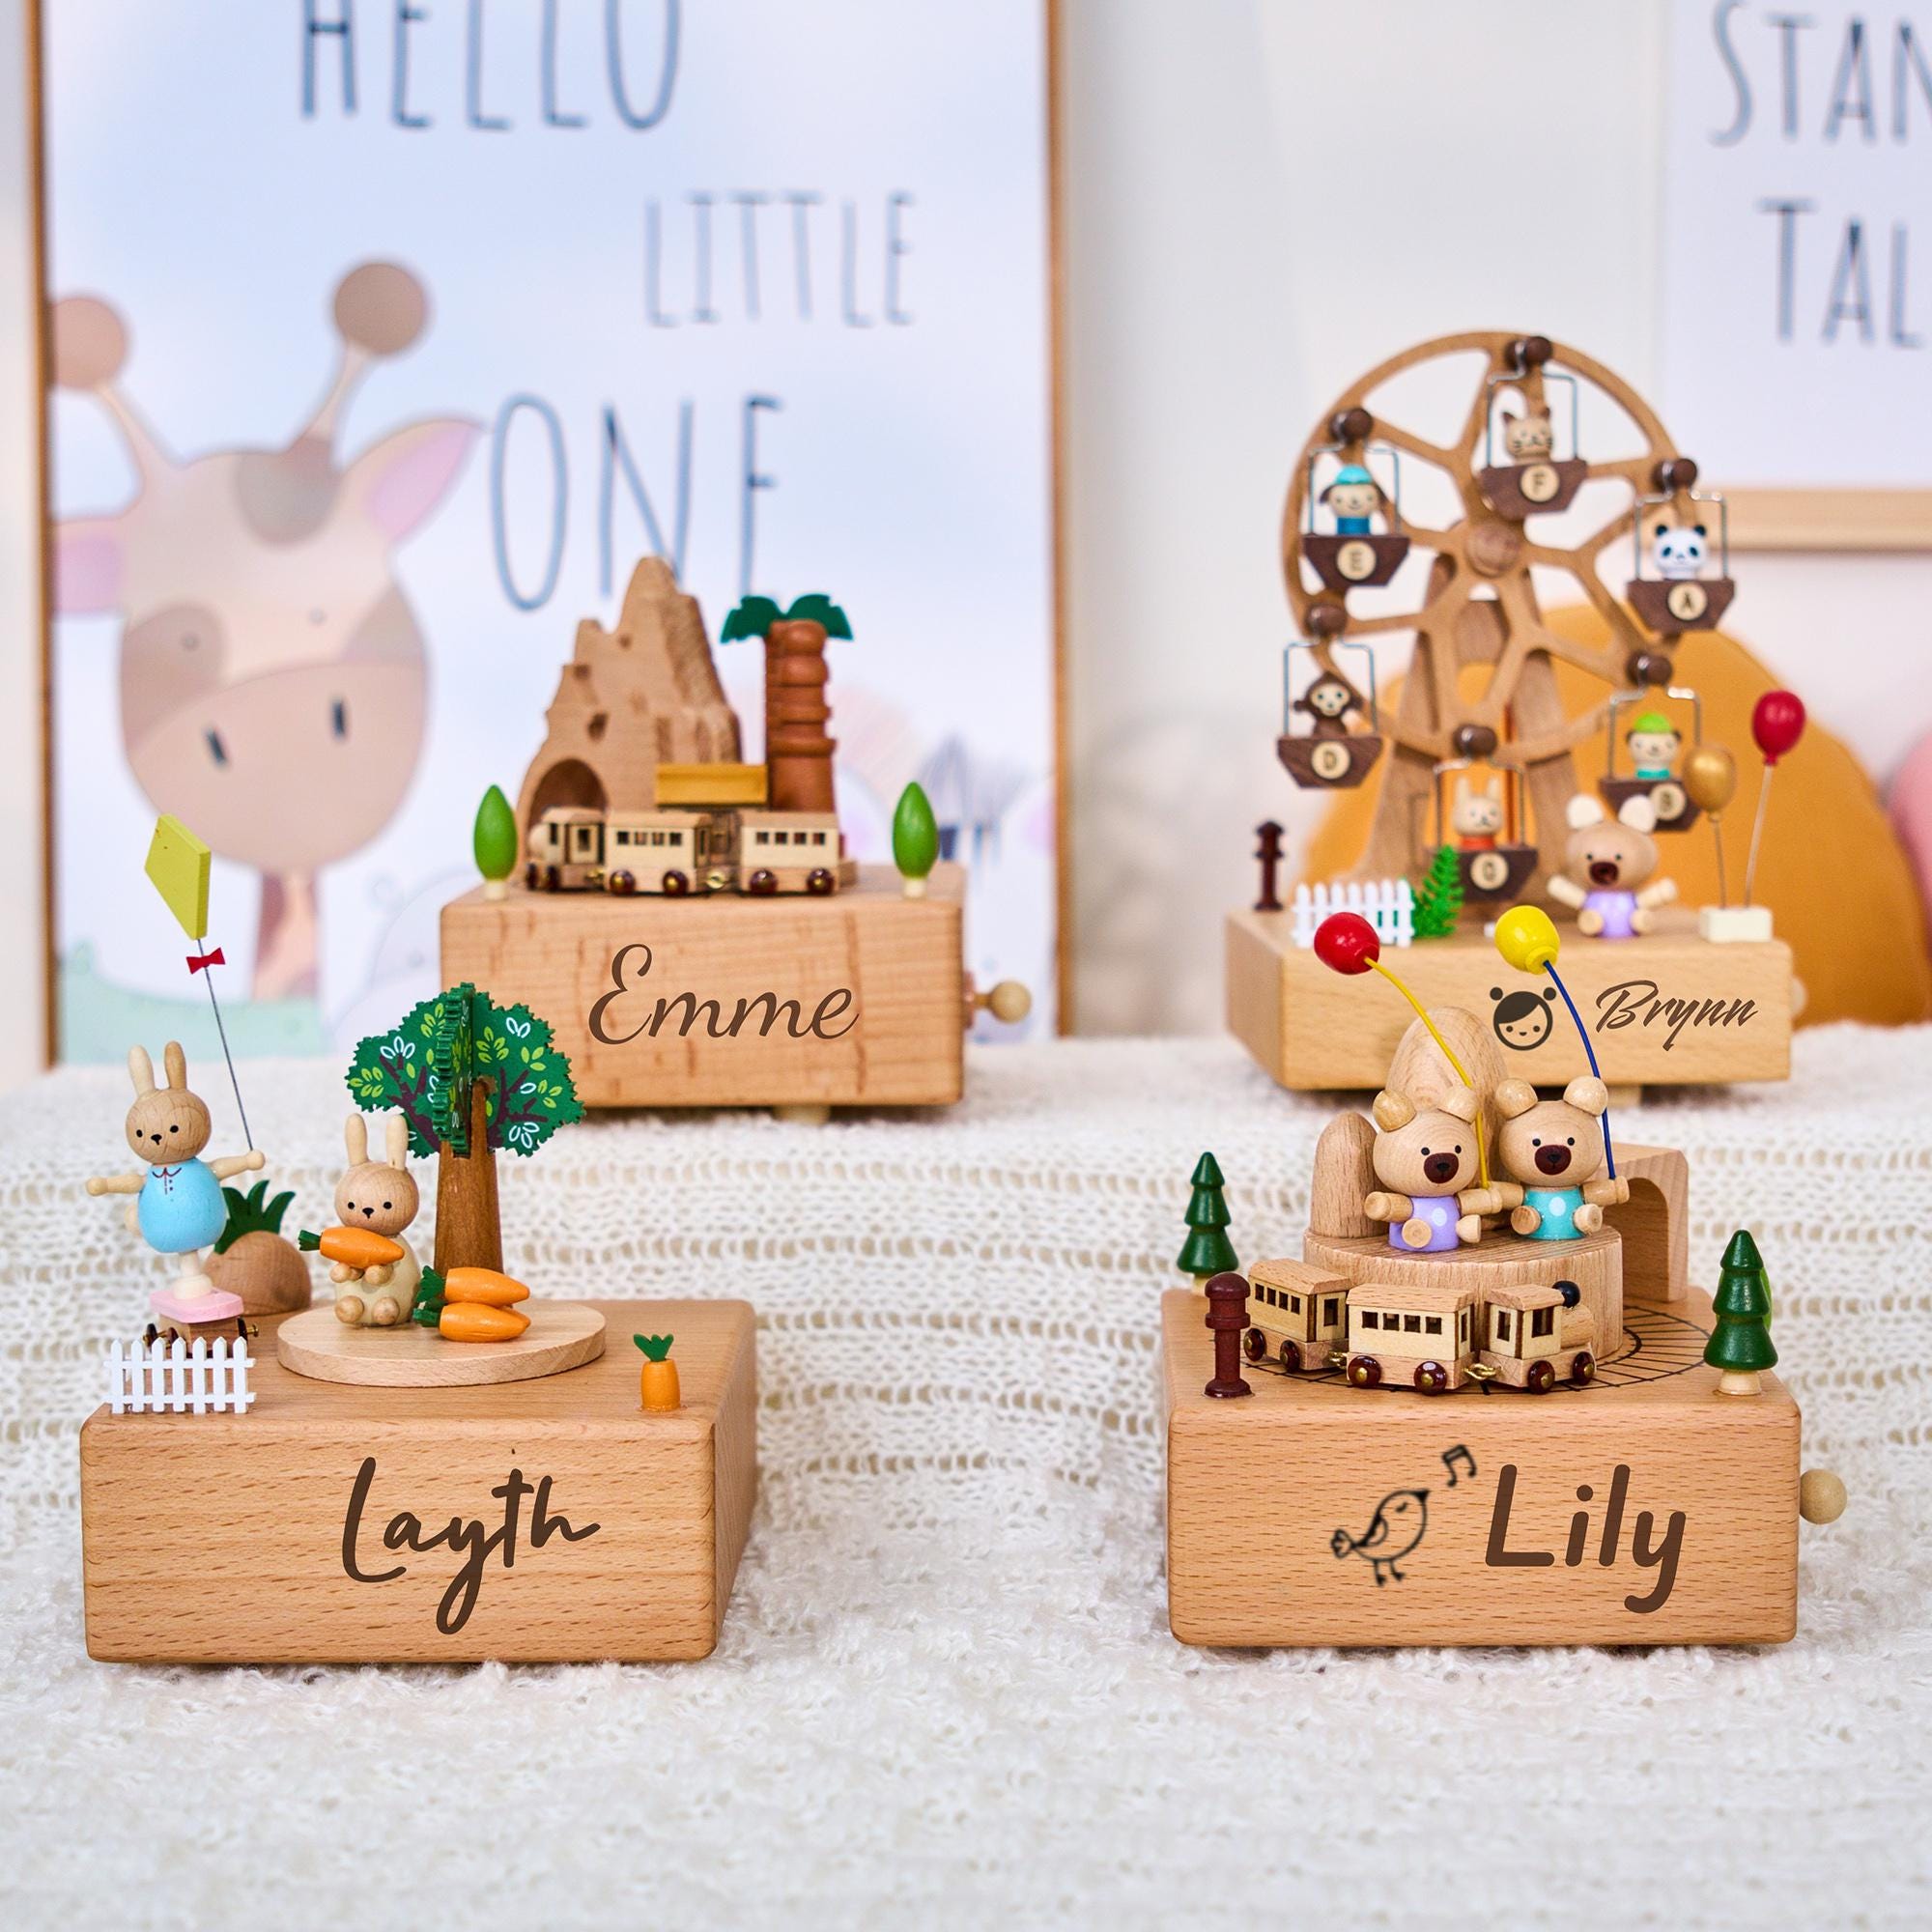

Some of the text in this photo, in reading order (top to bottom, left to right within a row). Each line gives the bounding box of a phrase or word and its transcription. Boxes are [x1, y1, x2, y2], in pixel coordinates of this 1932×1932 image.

[302, 0, 681, 129] HELLO
[645, 191, 914, 327] LITTLE
[588, 944, 860, 1045] Emme
[1596, 980, 1758, 1052] Brynn
[342, 1456, 601, 1634] Layth
[1485, 1463, 1687, 1614] Lily
